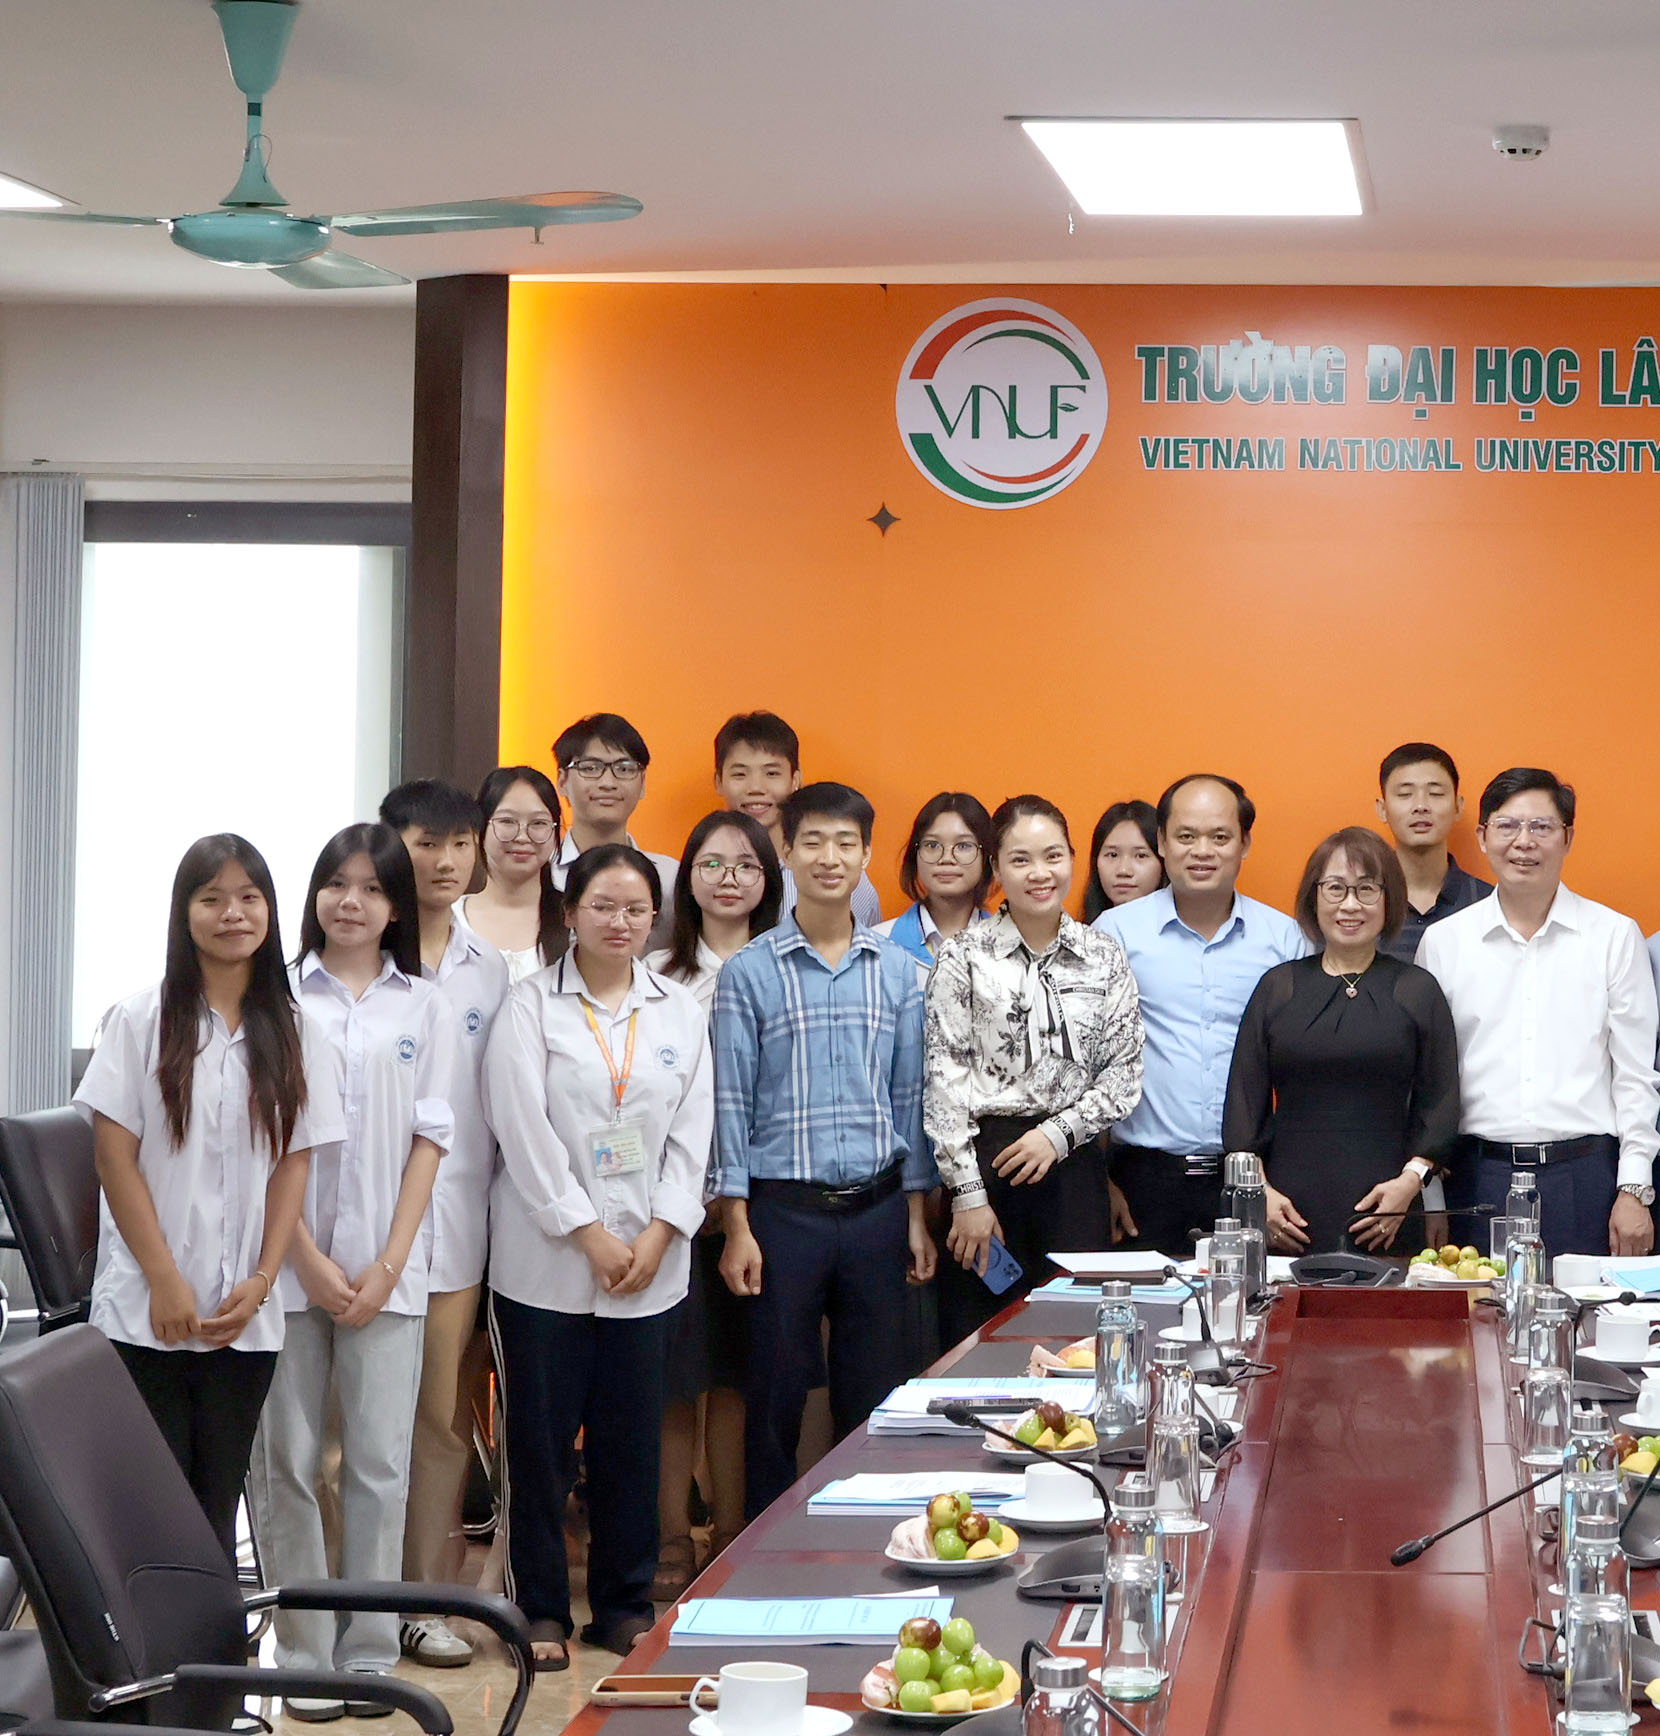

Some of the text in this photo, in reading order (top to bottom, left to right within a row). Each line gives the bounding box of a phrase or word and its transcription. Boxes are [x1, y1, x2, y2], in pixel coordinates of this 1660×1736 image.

[1135, 331, 1346, 404] TRƯỜNG
[1365, 344, 1456, 420] ĐẠI
[1473, 346, 1580, 422] HỌC
[924, 385, 1086, 439] VNUF
[1139, 436, 1285, 471] VIETNAM
[1298, 437, 1463, 472] NATIONAL
